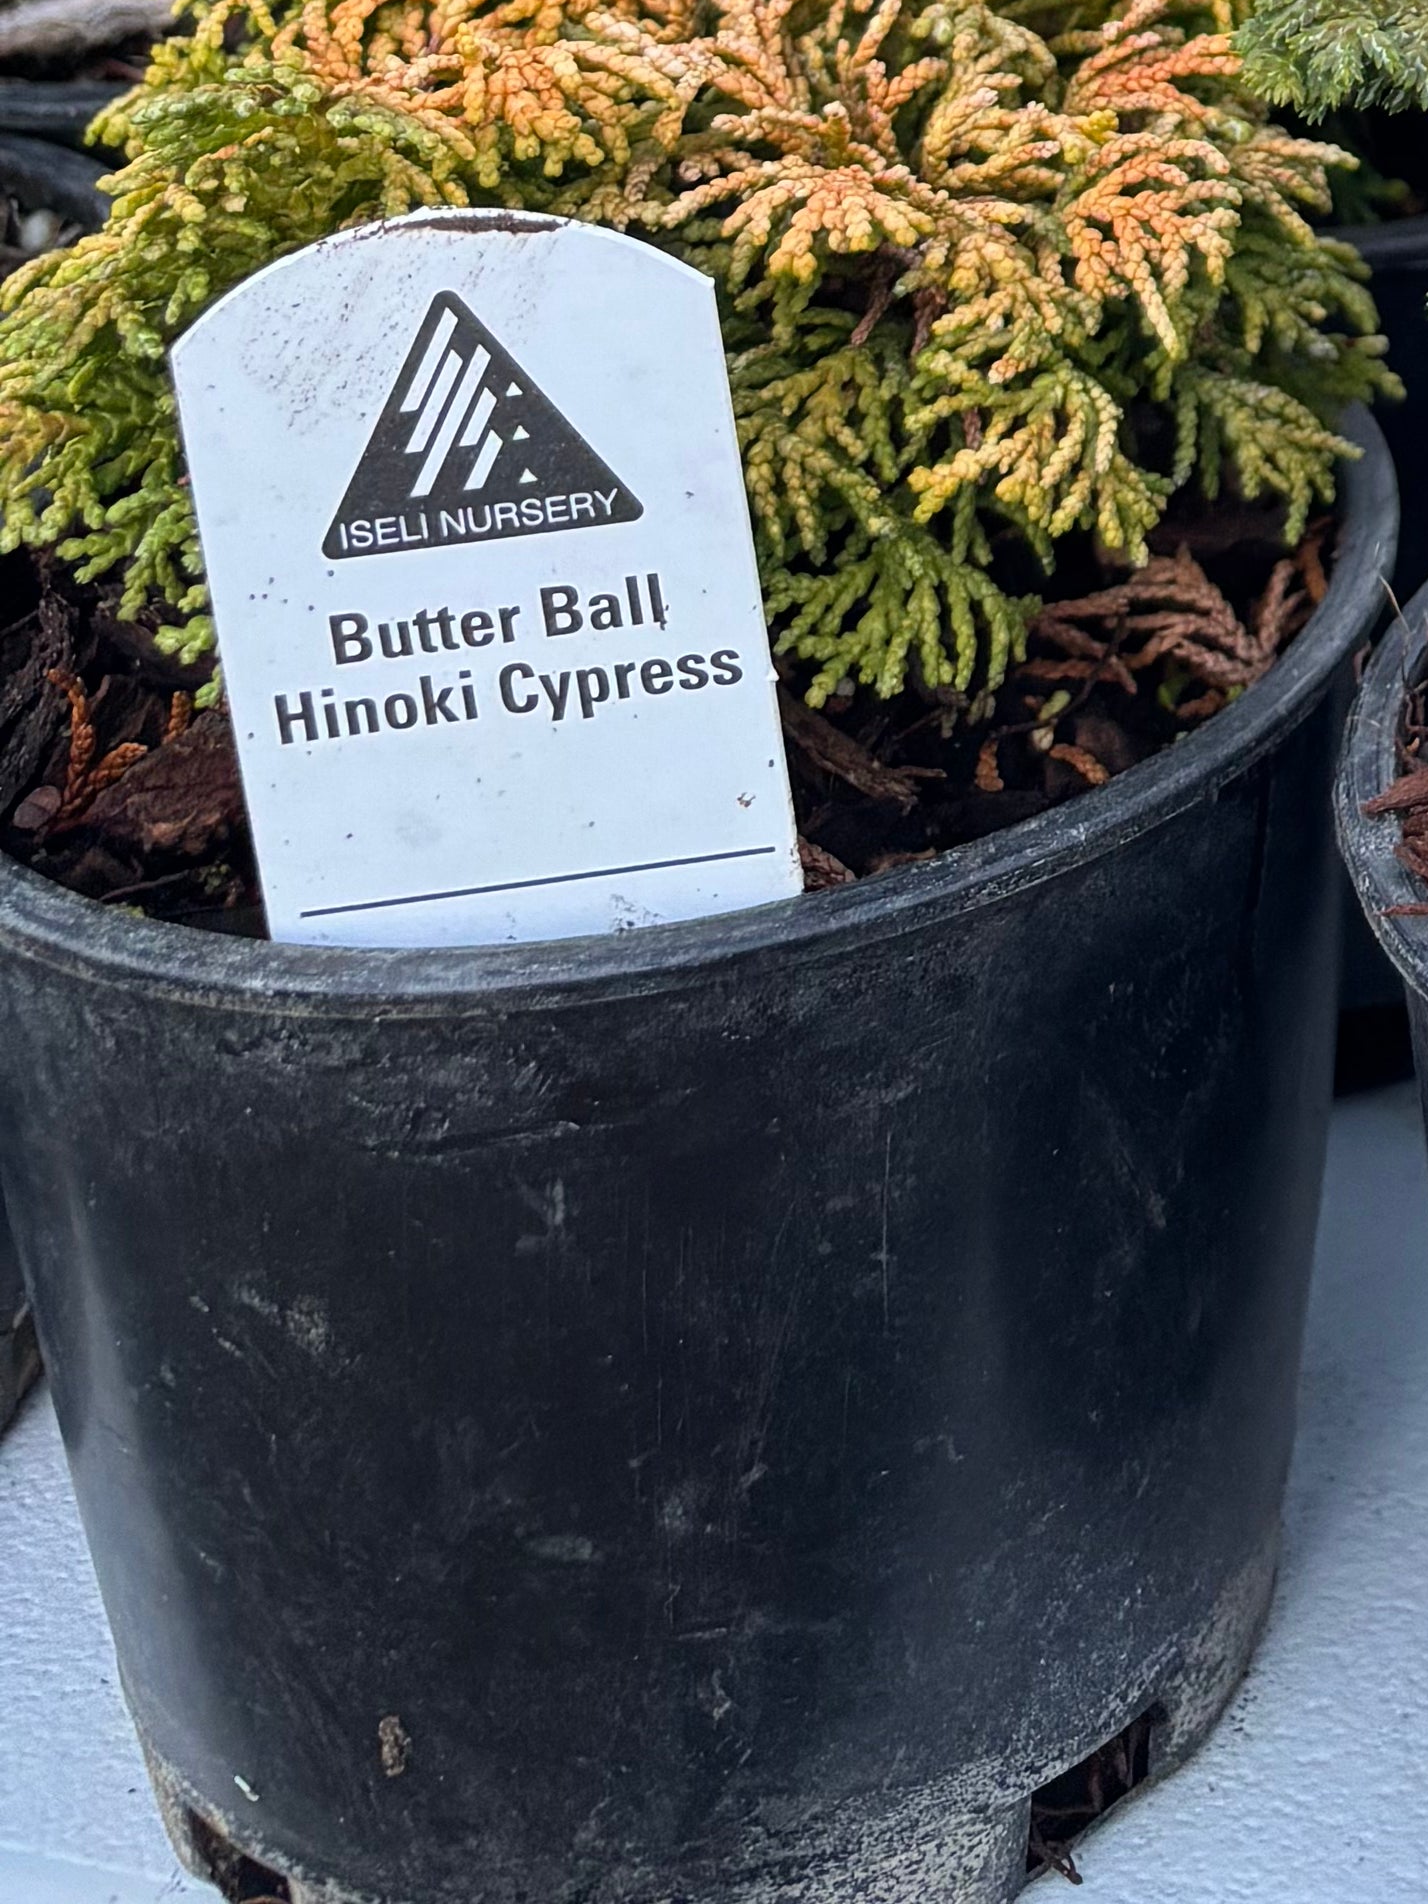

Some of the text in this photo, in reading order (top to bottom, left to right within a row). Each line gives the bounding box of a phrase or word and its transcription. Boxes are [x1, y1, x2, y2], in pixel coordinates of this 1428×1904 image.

[338, 486, 619, 552] ISELI NURSERY
[328, 572, 664, 666] Butter Ball
[273, 648, 744, 746] Hinoki Cypress
